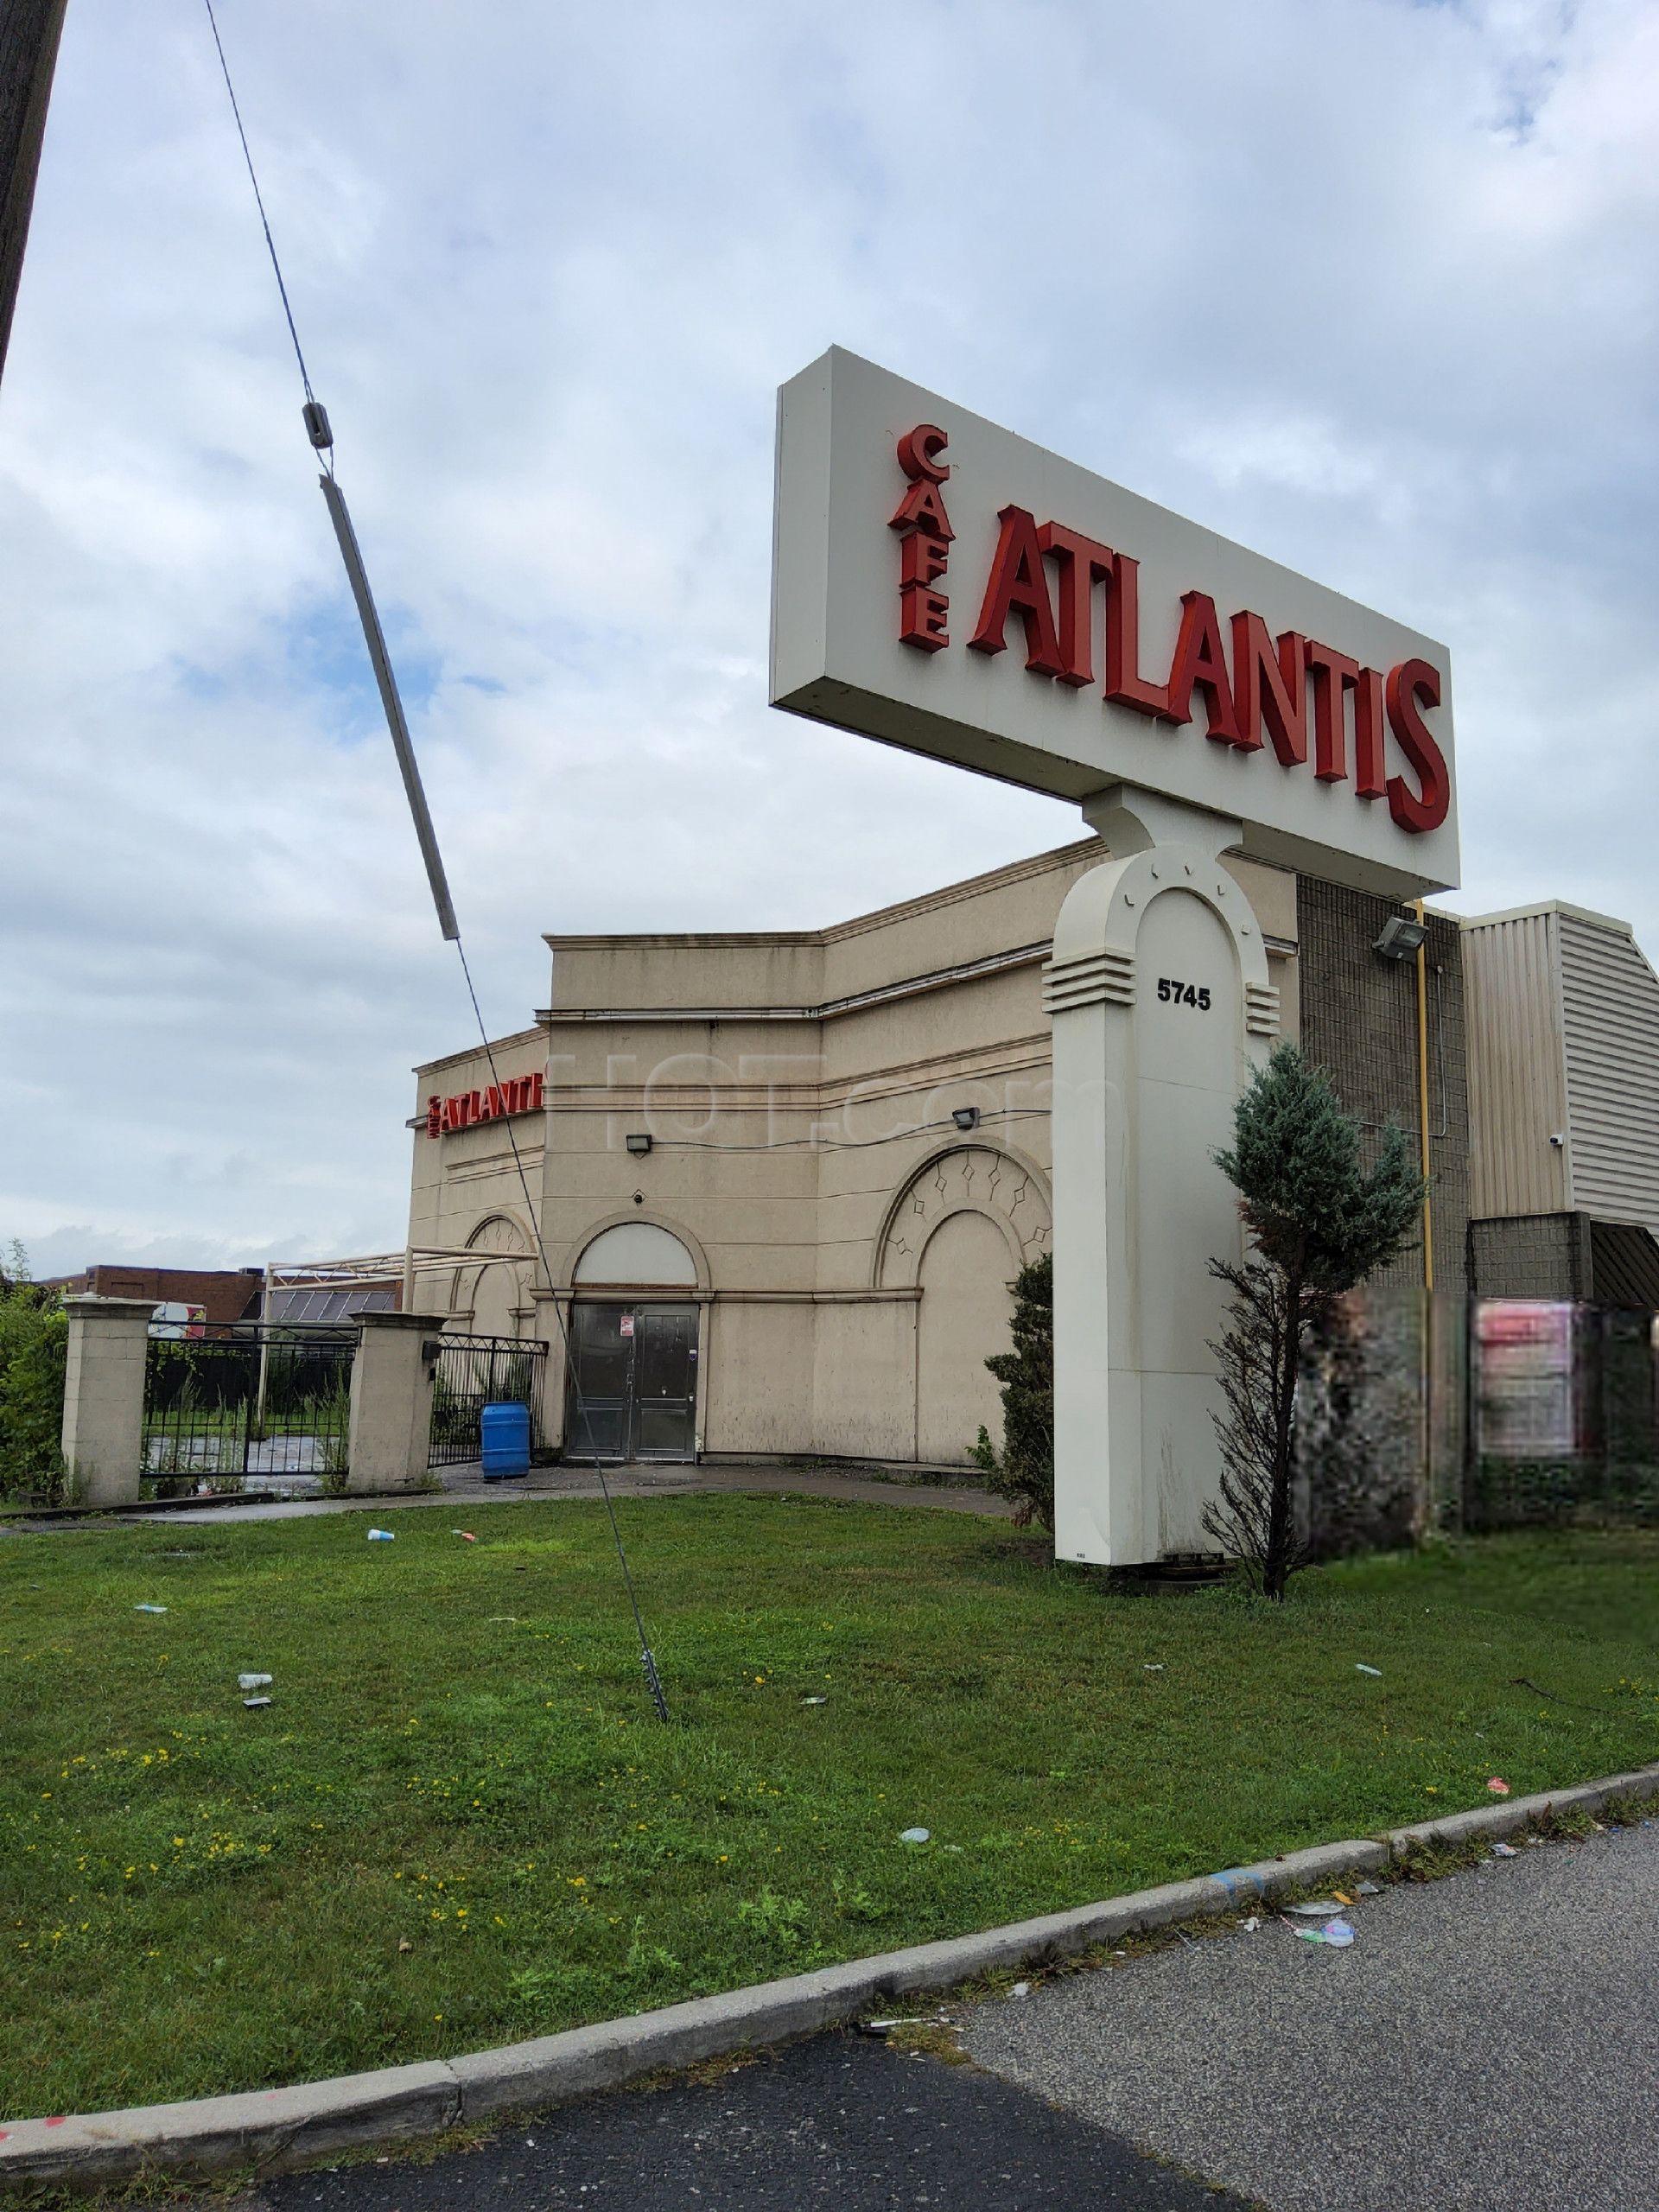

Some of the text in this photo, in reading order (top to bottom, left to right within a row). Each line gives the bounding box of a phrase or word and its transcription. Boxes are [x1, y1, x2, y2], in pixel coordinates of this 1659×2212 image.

[888, 423, 1450, 834] CAFE ATLANTIS
[1157, 978, 1211, 1011] 5745
[441, 1071, 547, 1132] ATLANTI
